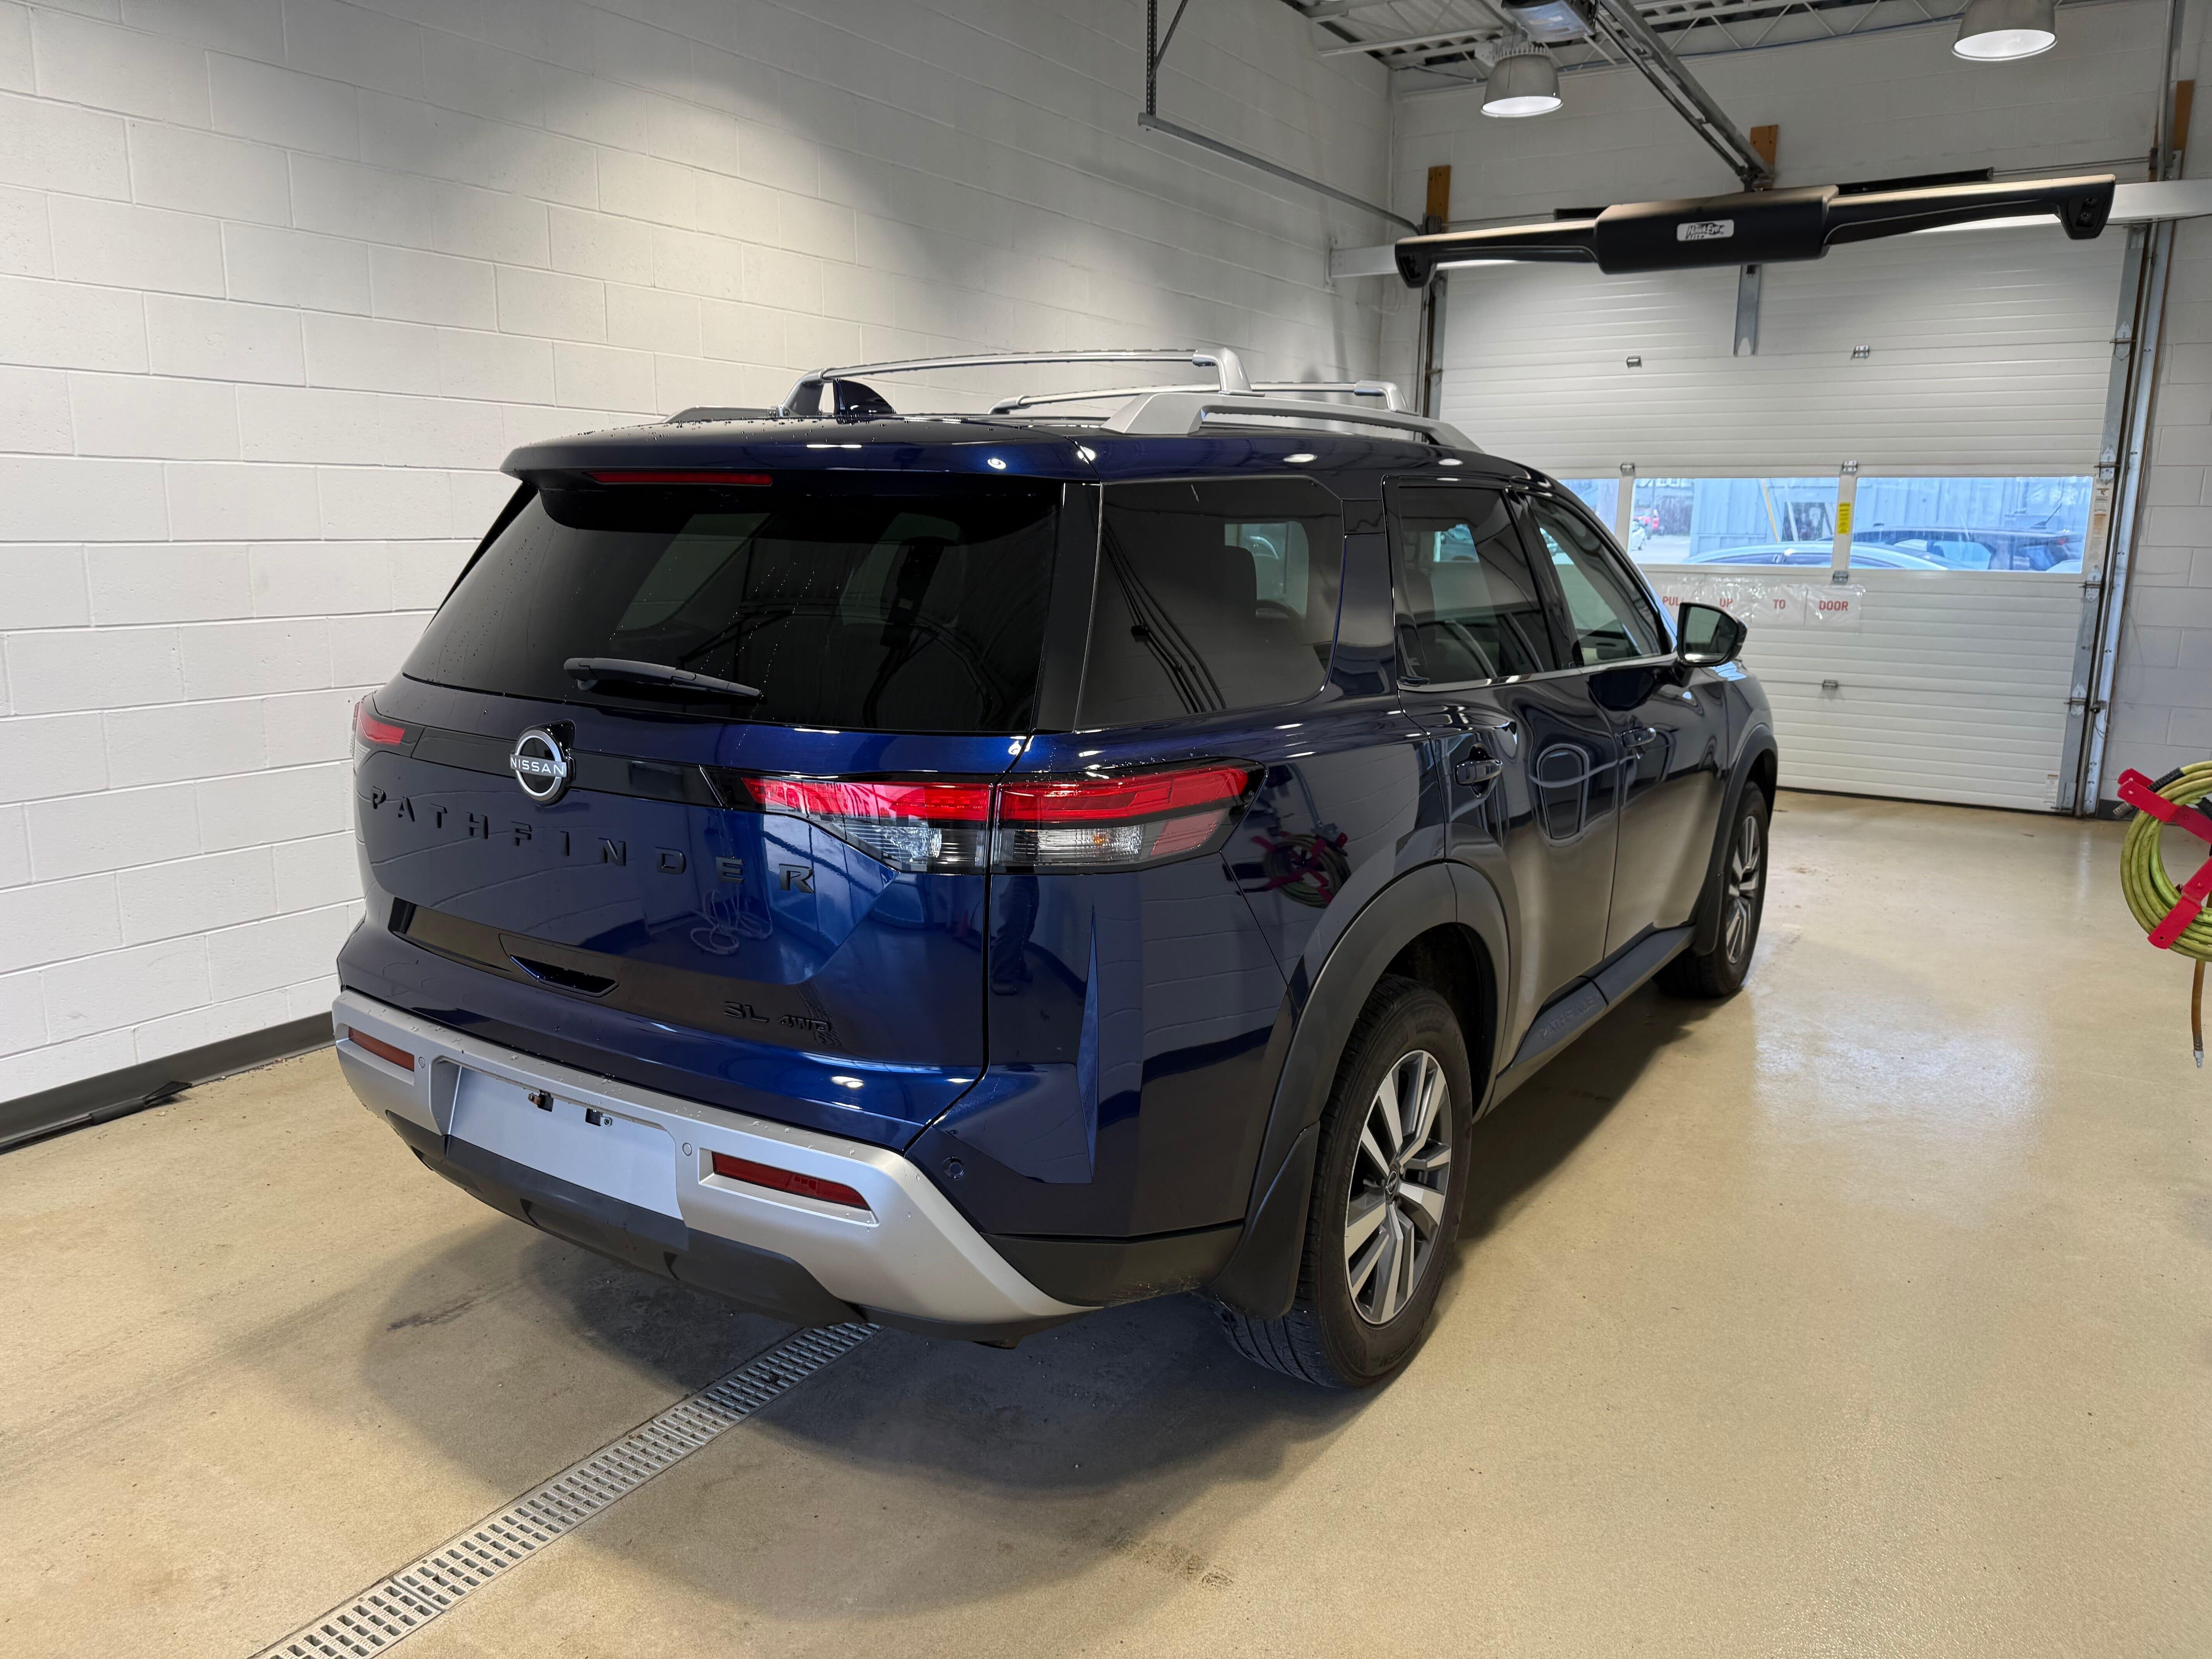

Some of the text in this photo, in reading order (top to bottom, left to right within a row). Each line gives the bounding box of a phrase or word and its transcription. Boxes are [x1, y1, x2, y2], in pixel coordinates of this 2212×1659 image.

[1662, 596, 1848, 611] PUL UP TO DOOR
[511, 757, 564, 775] NISSAN
[372, 785, 814, 893] PATHFINDER
[723, 1001, 769, 1024] SL
